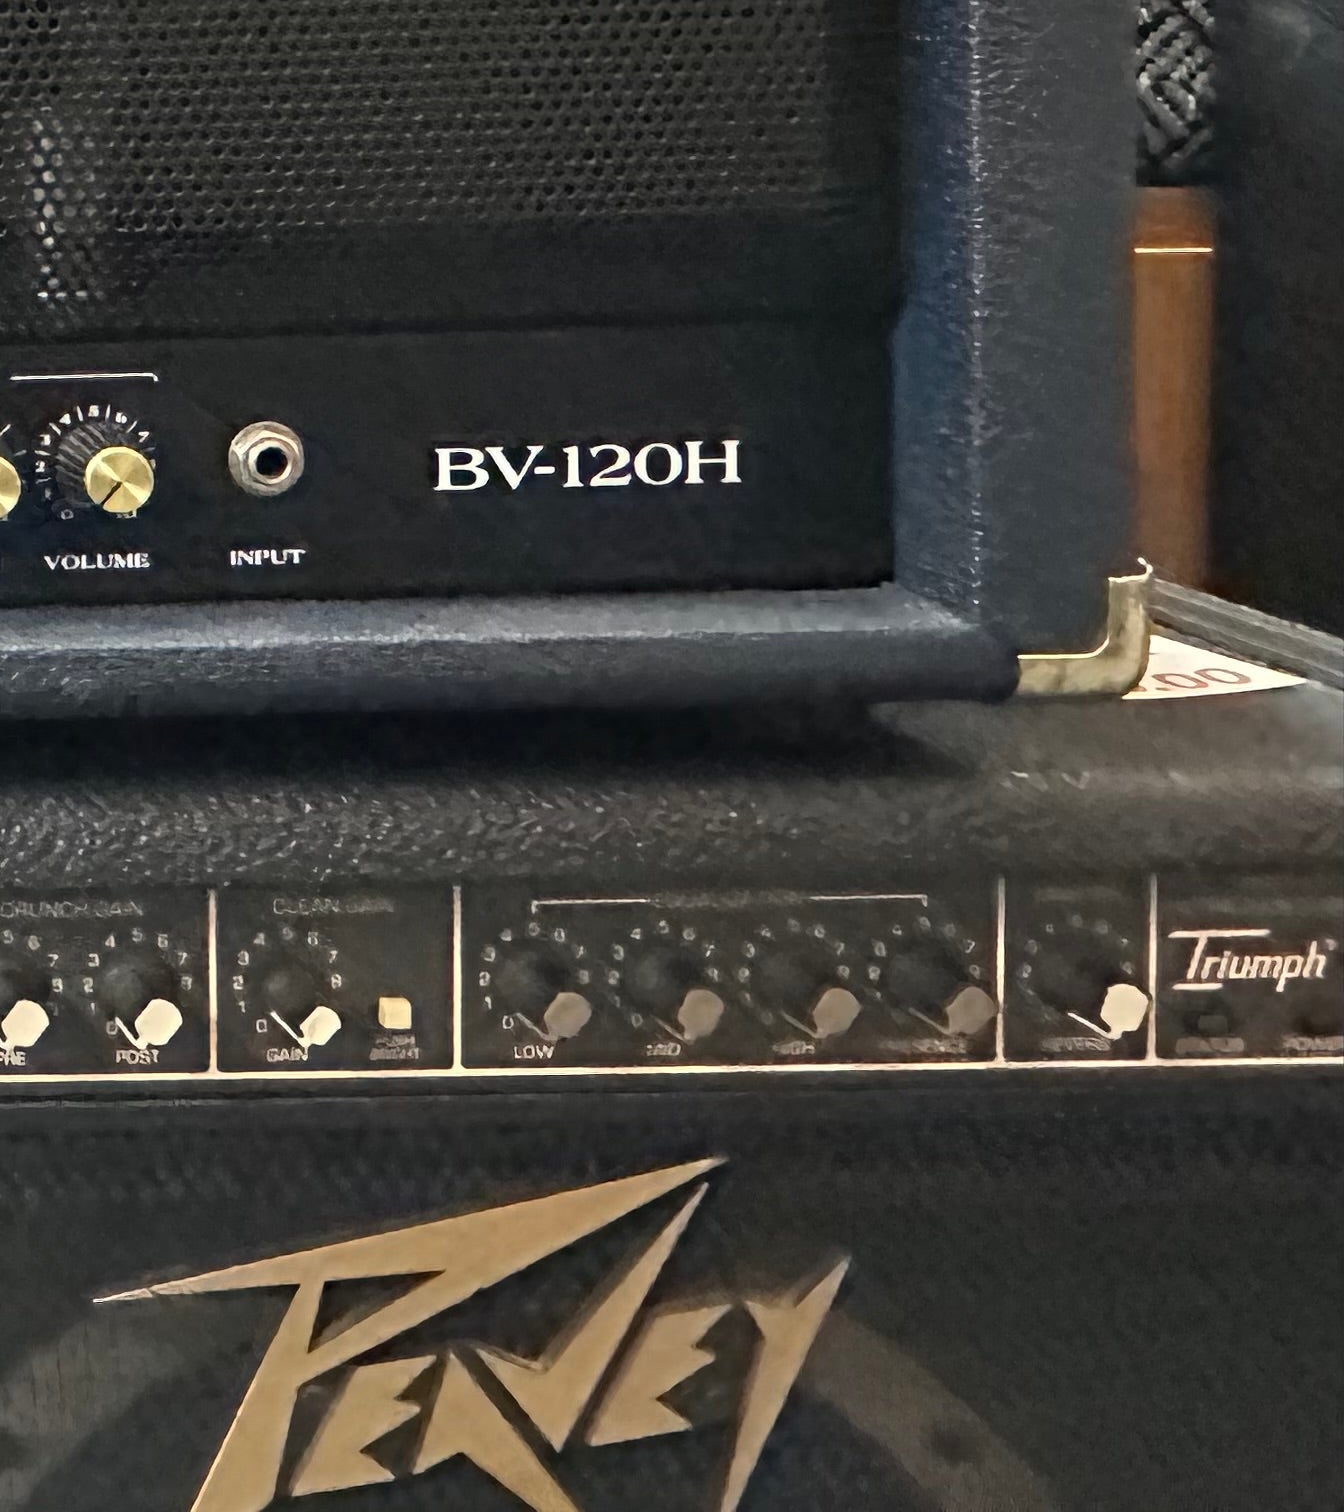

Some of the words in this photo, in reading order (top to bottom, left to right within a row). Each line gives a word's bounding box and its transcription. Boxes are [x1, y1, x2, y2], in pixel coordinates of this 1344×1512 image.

[138, 432, 150, 443] 7
[433, 439, 742, 491] BV-120H
[43, 552, 151, 570] VOLUME
[229, 548, 307, 566] INPUT
[1168, 928, 1328, 993] Triumph
[83, 977, 93, 992] 2
[115, 1049, 160, 1066] POST
[266, 1047, 309, 1062] GAIN
[514, 1044, 556, 1059] LOW
[92, 1155, 854, 1512] PEAVEY
